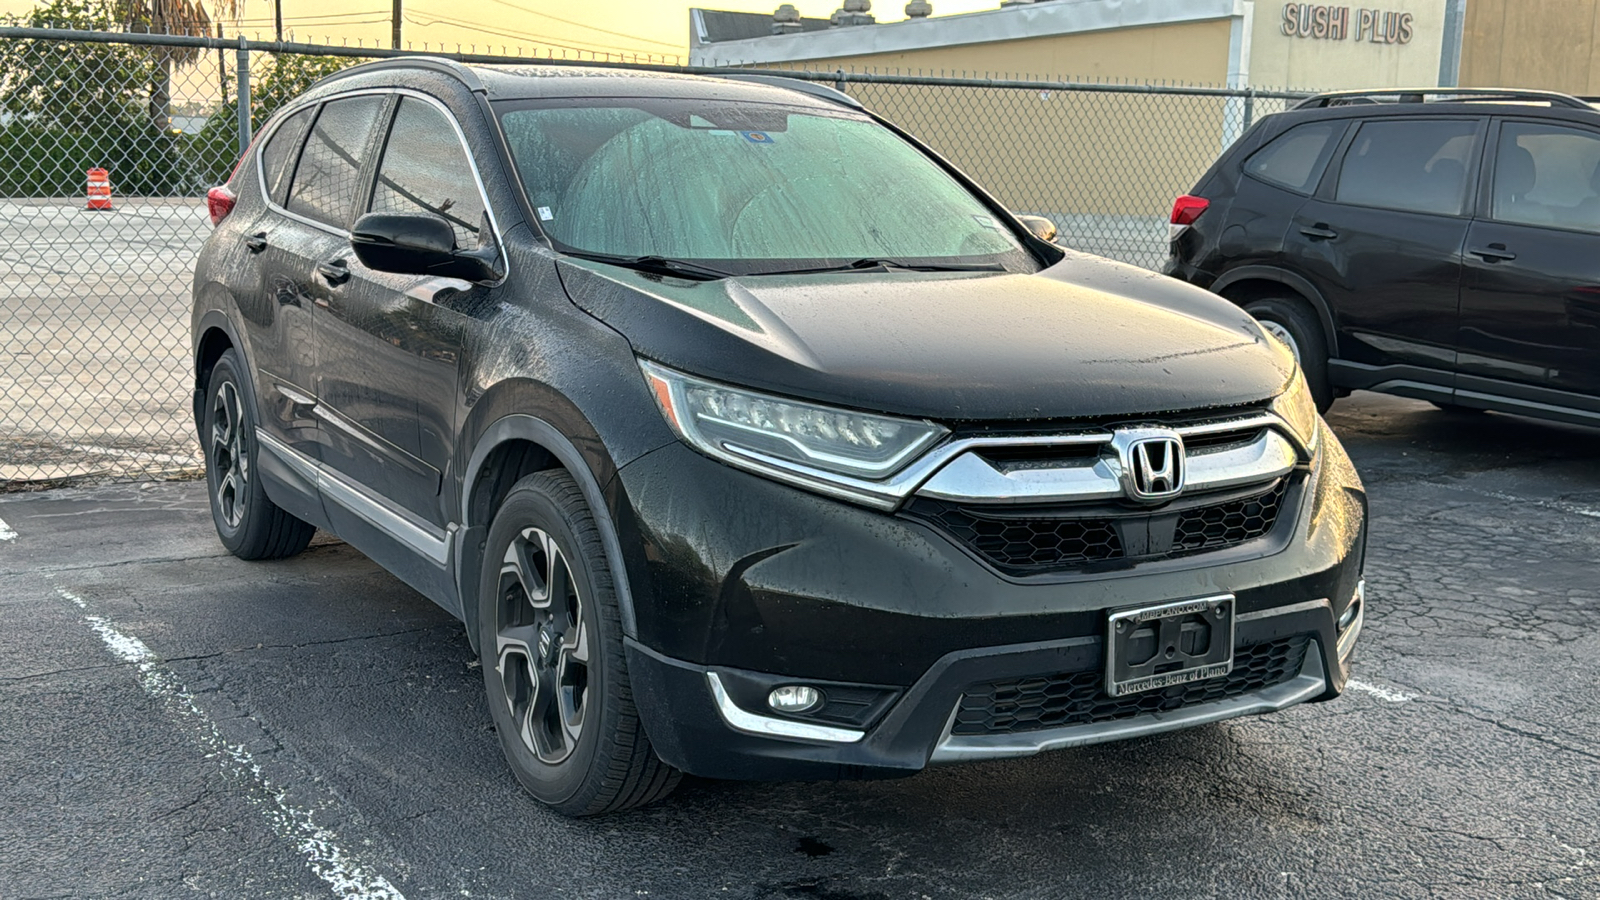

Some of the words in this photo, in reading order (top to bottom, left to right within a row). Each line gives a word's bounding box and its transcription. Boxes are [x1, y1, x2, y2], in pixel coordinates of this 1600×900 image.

[1280, 3, 1349, 40] SUSHI
[1355, 9, 1413, 44] PLUS
[1119, 674, 1187, 694] Mercedes-Benz
[1189, 669, 1199, 681] of
[1200, 666, 1226, 680] Plano
